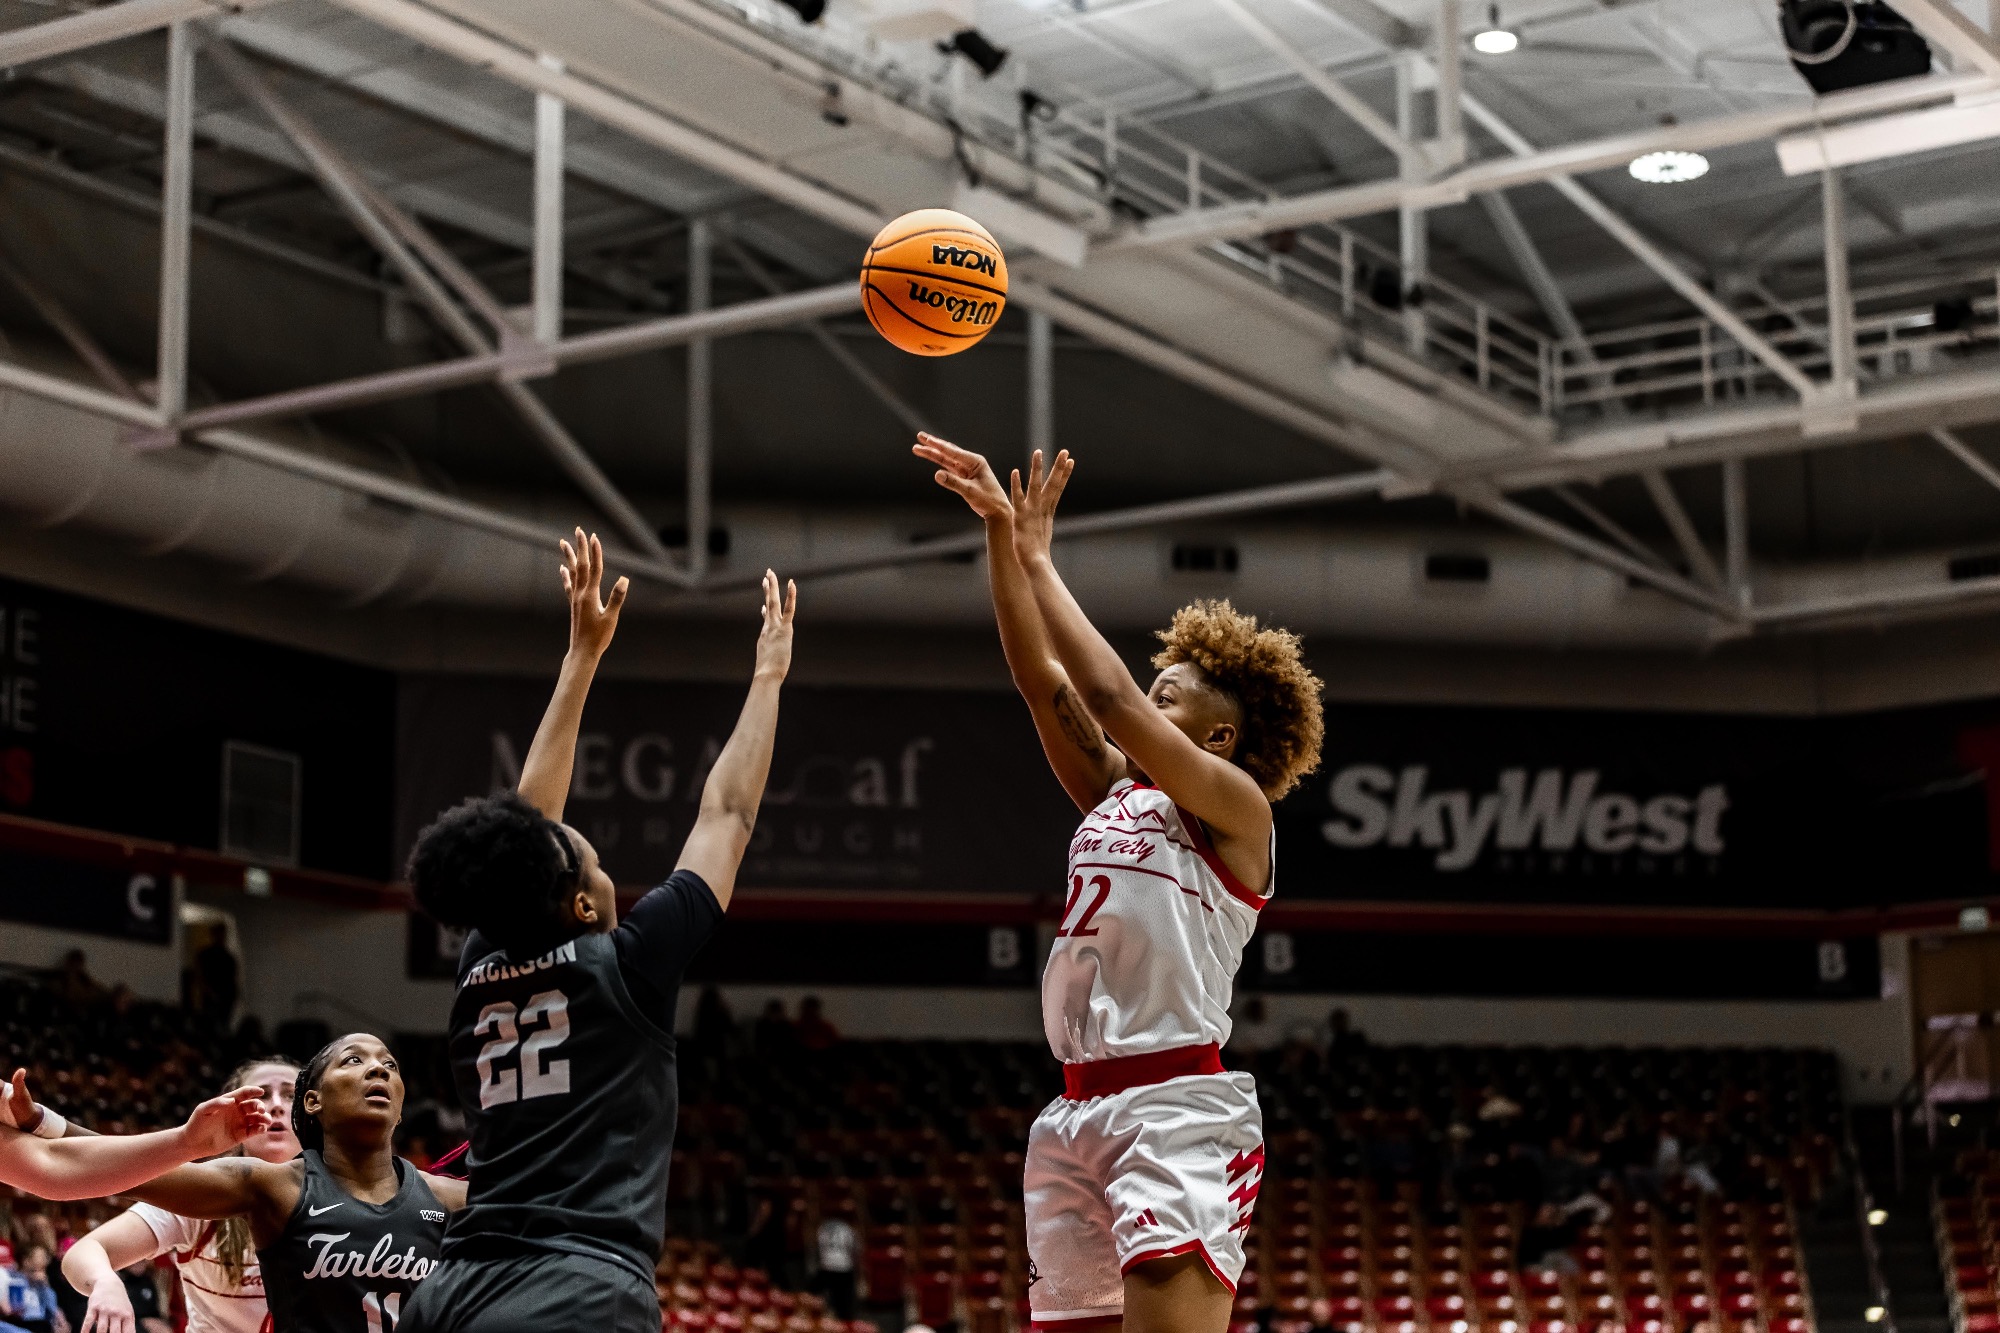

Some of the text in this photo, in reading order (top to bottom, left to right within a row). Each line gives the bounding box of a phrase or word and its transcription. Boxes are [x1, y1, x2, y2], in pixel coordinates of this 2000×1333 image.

[932, 244, 997, 278] NCAA
[909, 282, 998, 325] Wilson
[1320, 763, 1730, 873] SkyWest
[126, 872, 157, 921] C
[474, 988, 572, 1111] 22
[419, 1209, 446, 1223] WAC
